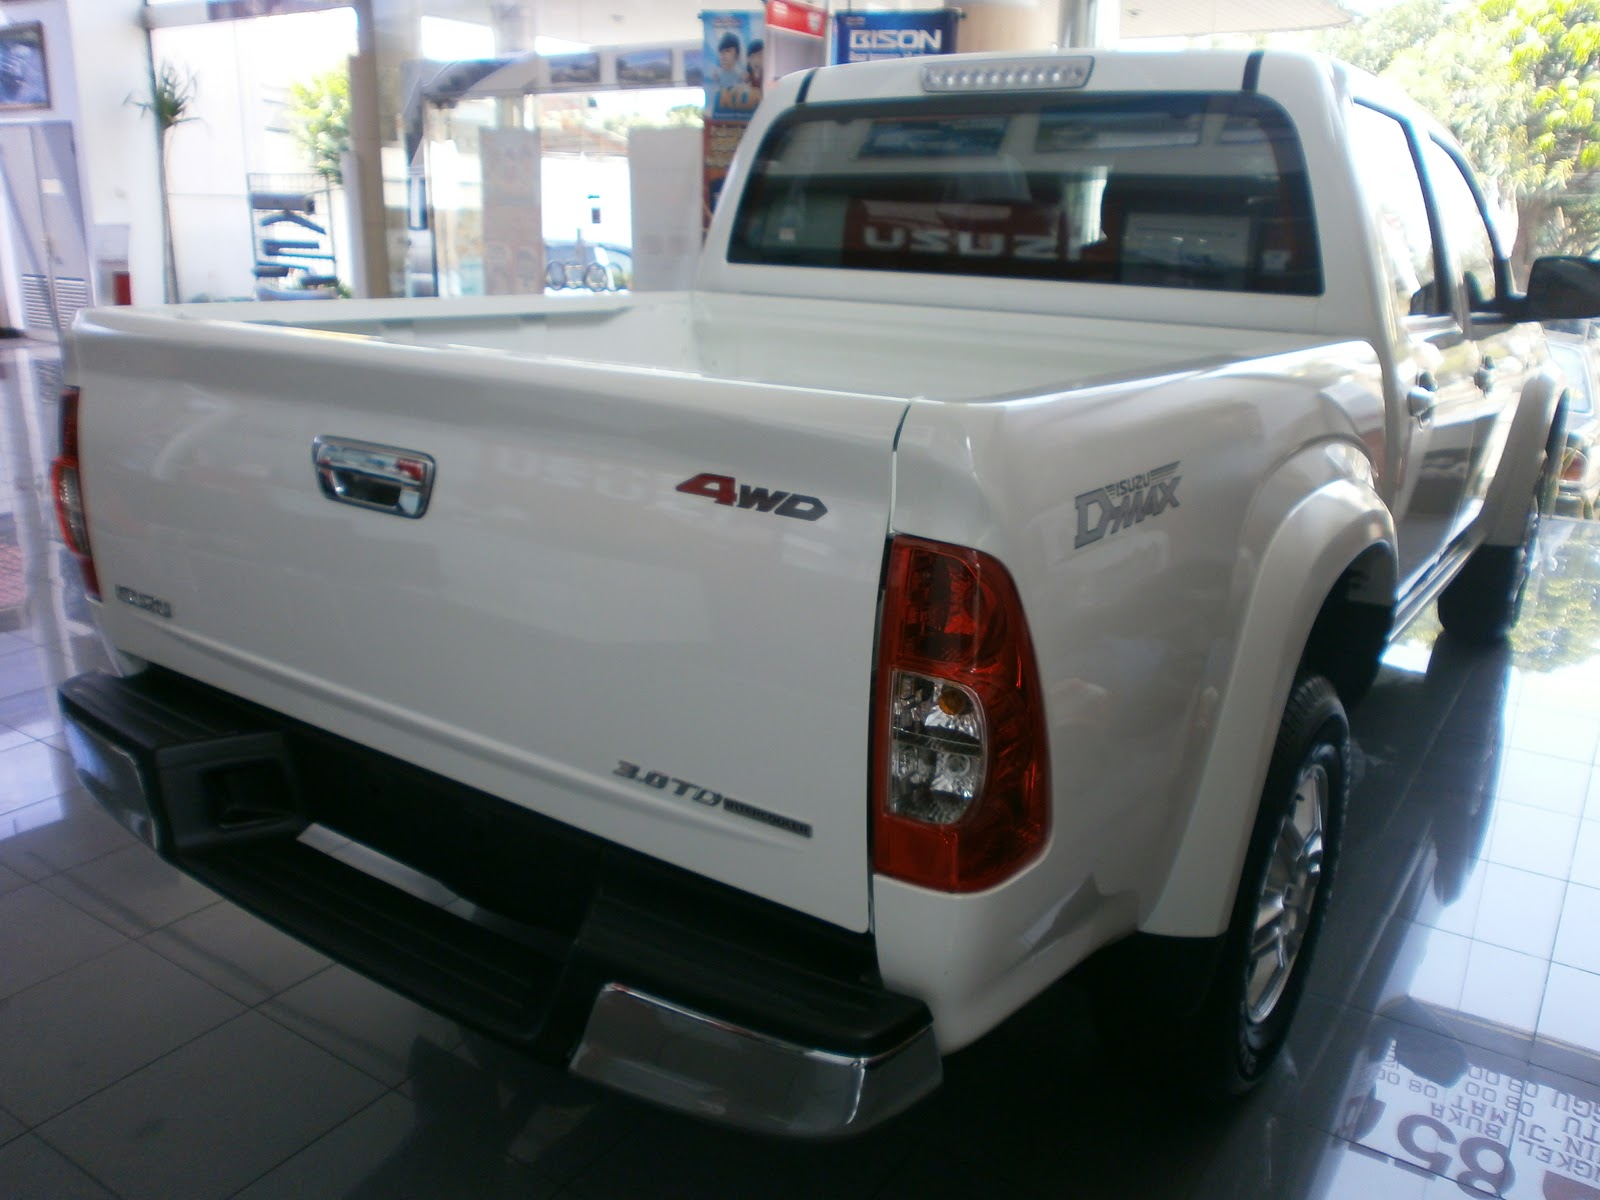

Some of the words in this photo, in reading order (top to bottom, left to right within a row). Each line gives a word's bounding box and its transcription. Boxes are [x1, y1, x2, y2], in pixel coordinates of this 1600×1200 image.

[849, 29, 942, 49] BISON
[675, 472, 828, 521] 4WD
[1116, 472, 1151, 497] ISUZU
